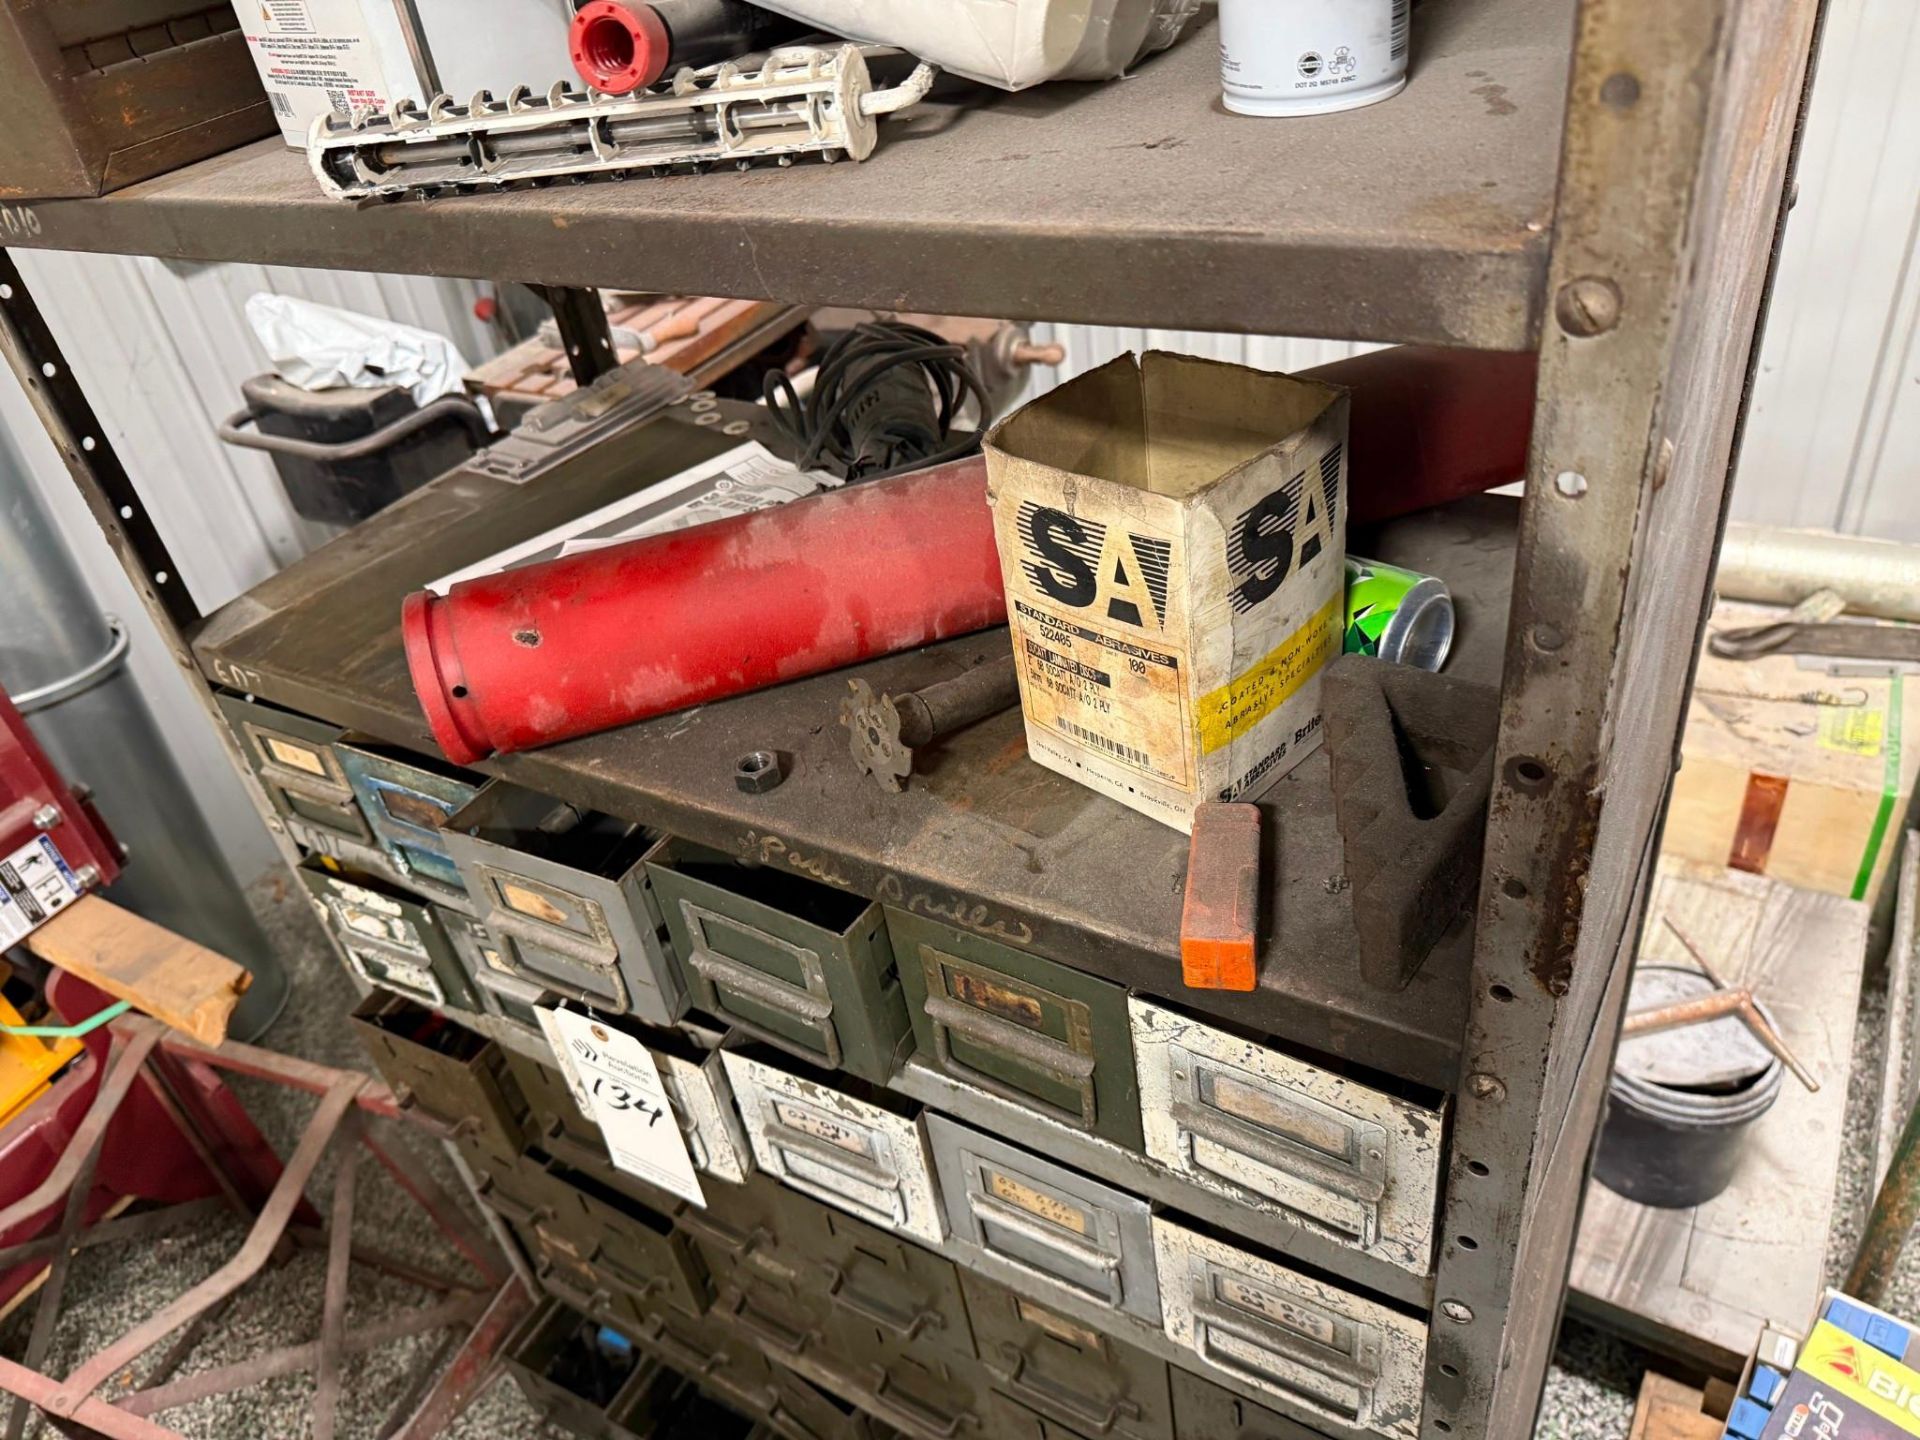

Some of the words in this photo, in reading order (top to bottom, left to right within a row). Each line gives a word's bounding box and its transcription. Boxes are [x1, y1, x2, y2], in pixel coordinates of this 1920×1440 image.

[1229, 446, 1341, 613] SA
[1017, 501, 1171, 633] SA
[1019, 603, 1080, 635] STANDARD
[1095, 634, 1170, 665] ABRASIVES
[1040, 624, 1072, 648] 522405
[1049, 651, 1078, 674] LAMINATED
[1128, 657, 1146, 675] 100
[1224, 688, 1275, 730] ABRASIVE
[1279, 633, 1333, 690] SPECIALTIES
[1083, 679, 1088, 692] 2
[1089, 682, 1101, 696] PLY
[1093, 698, 1098, 709] 2
[1099, 700, 1111, 713] PLY
[1220, 675, 1265, 711] COATED
[1243, 748, 1288, 790] ABRASIVES
[1244, 742, 1286, 781] STANDARD
[1063, 756, 1072, 764] CA
[1114, 780, 1123, 788] CA
[1174, 805, 1187, 814] OH
[593, 1078, 663, 1128] 134
